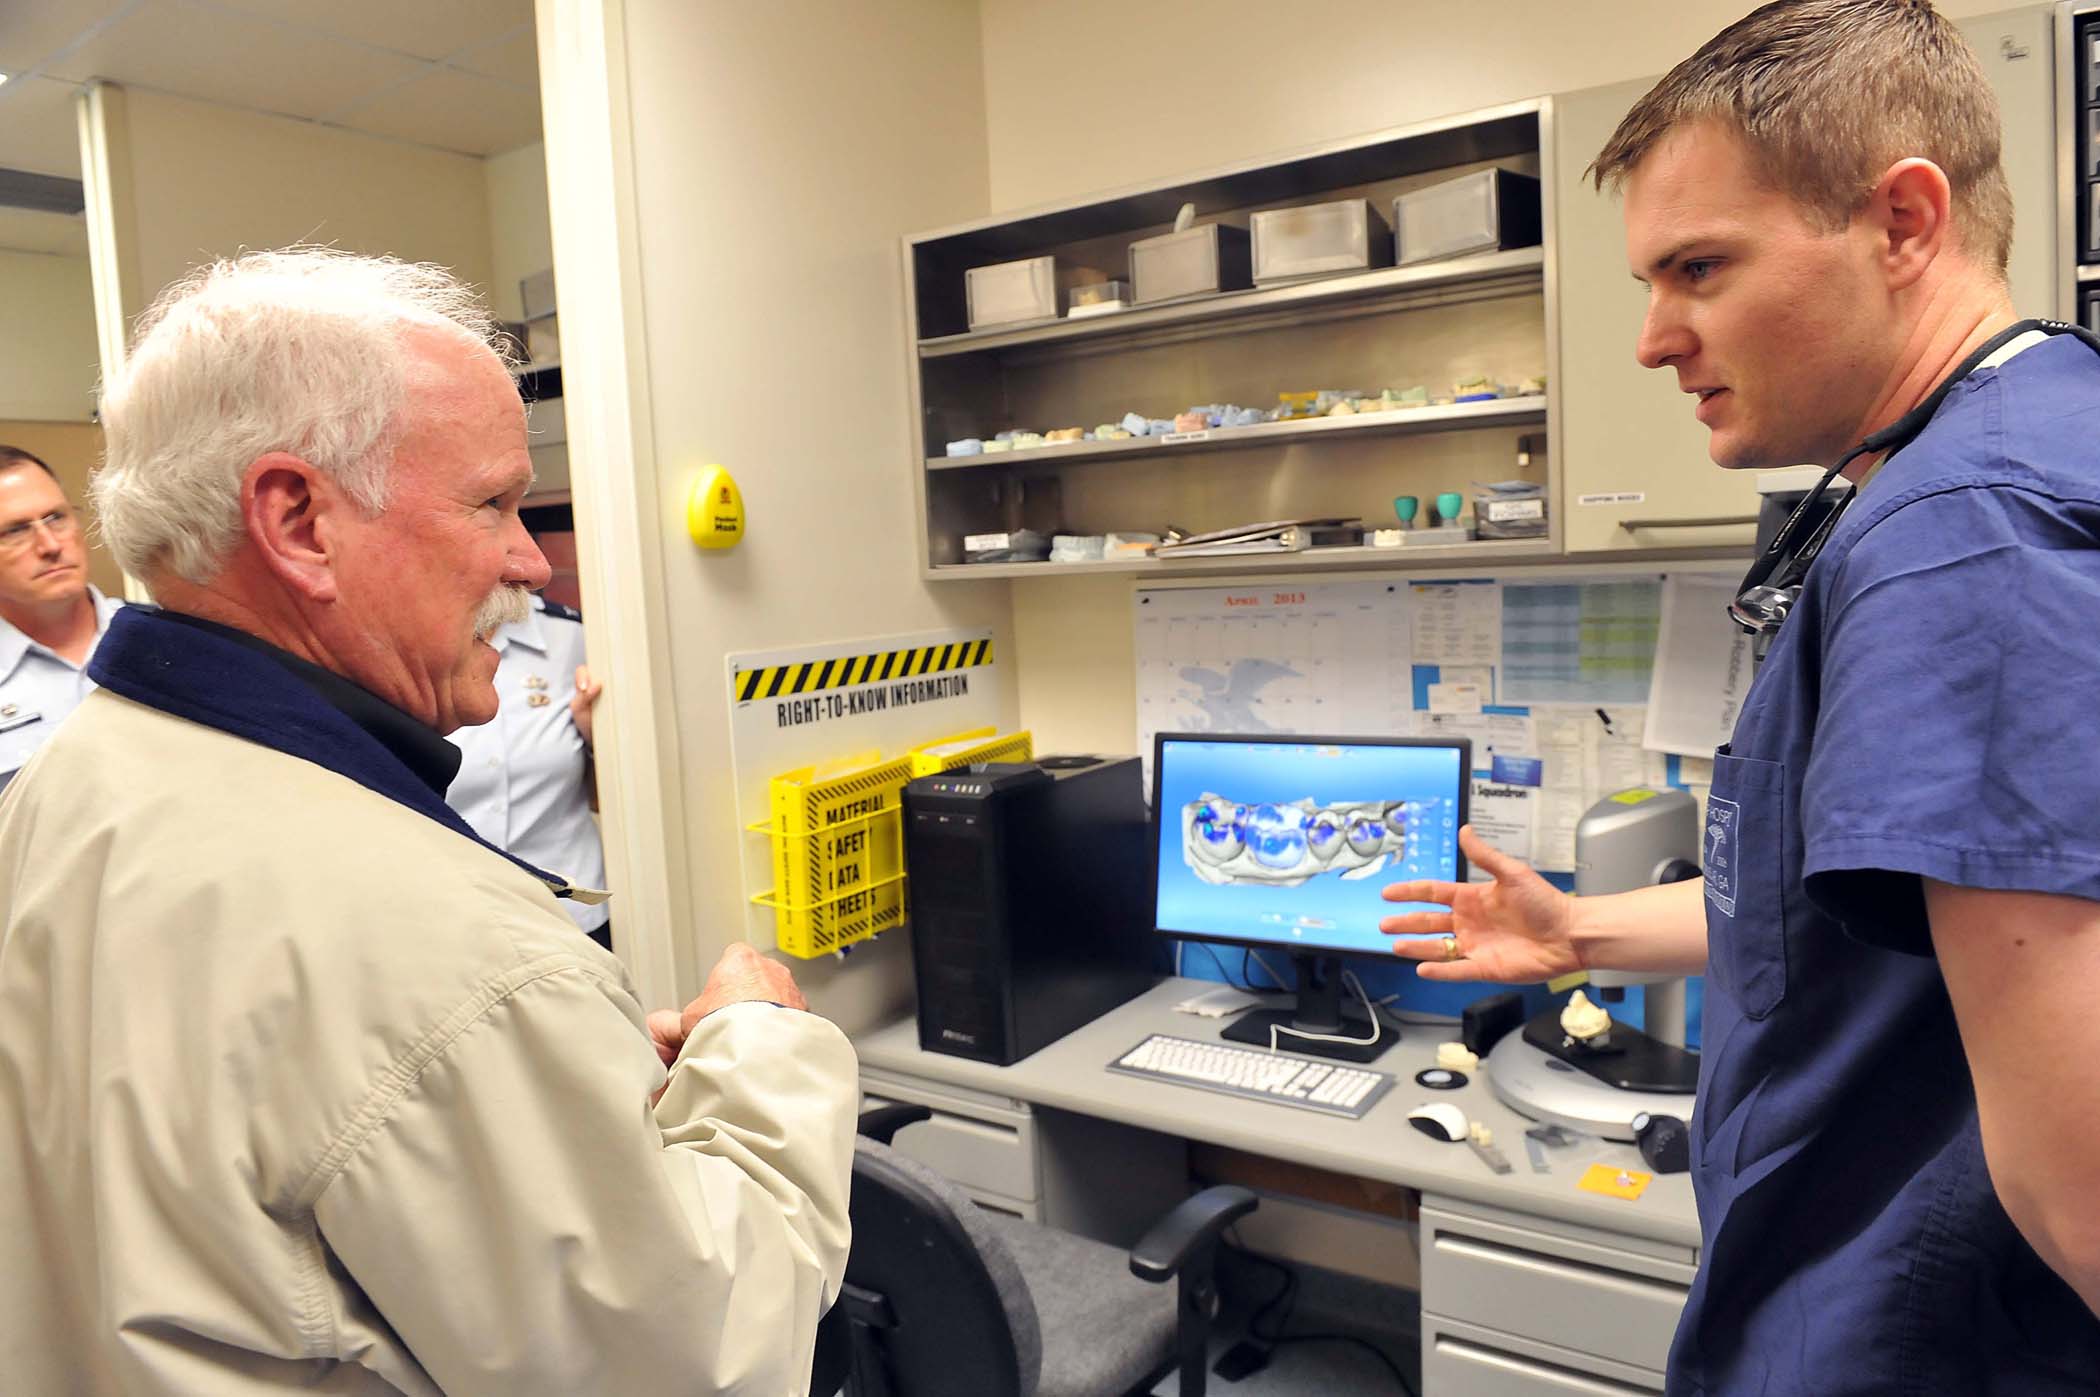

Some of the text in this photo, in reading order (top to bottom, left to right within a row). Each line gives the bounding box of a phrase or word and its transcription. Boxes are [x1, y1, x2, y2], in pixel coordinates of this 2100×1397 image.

[715, 524, 737, 532] Mask
[1272, 592, 1307, 605] 2013
[777, 674, 969, 728] RIGHT-TO-KNOW INFORMATION
[1477, 784, 1528, 799] Squadron
[827, 827, 873, 861] AFET
